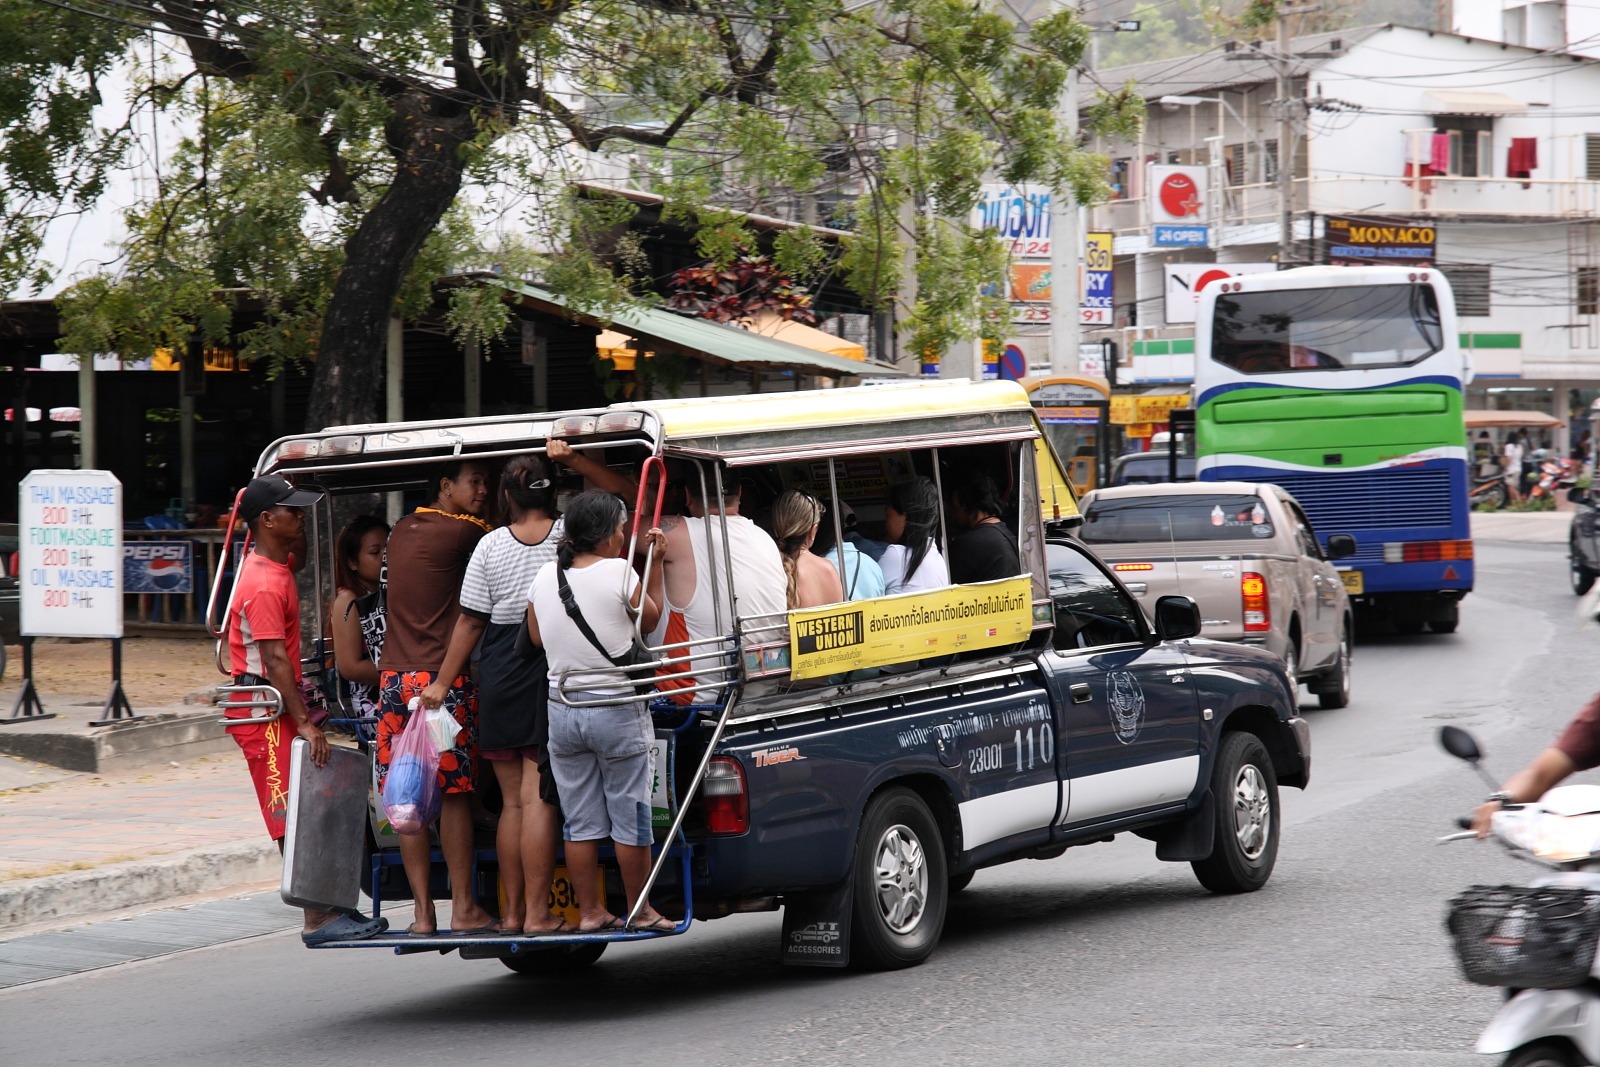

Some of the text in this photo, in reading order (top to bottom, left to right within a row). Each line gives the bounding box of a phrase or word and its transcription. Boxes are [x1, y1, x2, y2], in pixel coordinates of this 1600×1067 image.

[1158, 230, 1205, 242] 24 OPEN
[1349, 227, 1435, 243] MONACO
[30, 486, 115, 505] THAI MASSAGE
[42, 506, 67, 525] 200
[42, 548, 68, 566] 200
[122, 545, 185, 560] PEPSI
[31, 568, 115, 589] OIL MASSAGE
[797, 613, 854, 638] WESTERN
[816, 629, 854, 650] UNION
[769, 744, 790, 752] HILUX
[968, 743, 1003, 775] 23001
[1013, 722, 1055, 773] 110
[788, 945, 841, 955] ACCESSORIES
